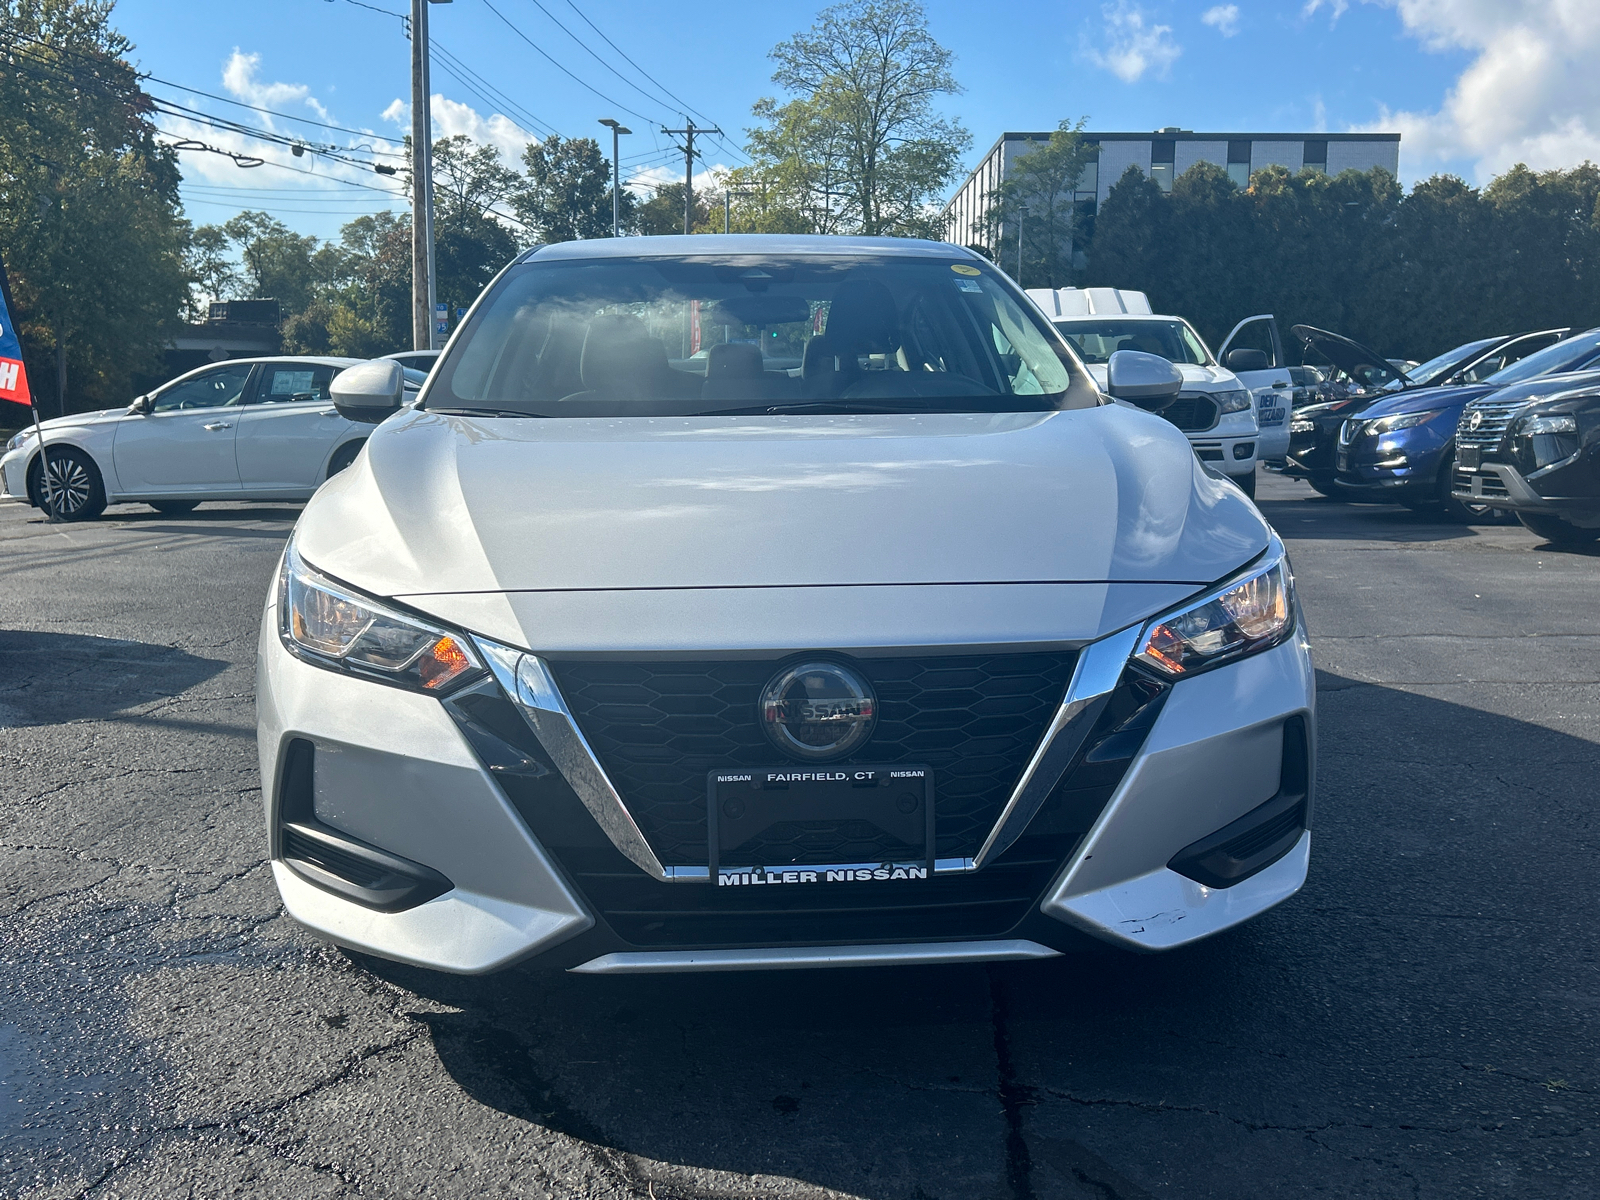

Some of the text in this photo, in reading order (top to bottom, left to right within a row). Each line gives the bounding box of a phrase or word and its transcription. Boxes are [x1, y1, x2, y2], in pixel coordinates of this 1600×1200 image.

[776, 701, 862, 719] NISSAN
[767, 771, 875, 781] FAIRFIELD, CT
[718, 868, 928, 886] MILLER NISSAN
